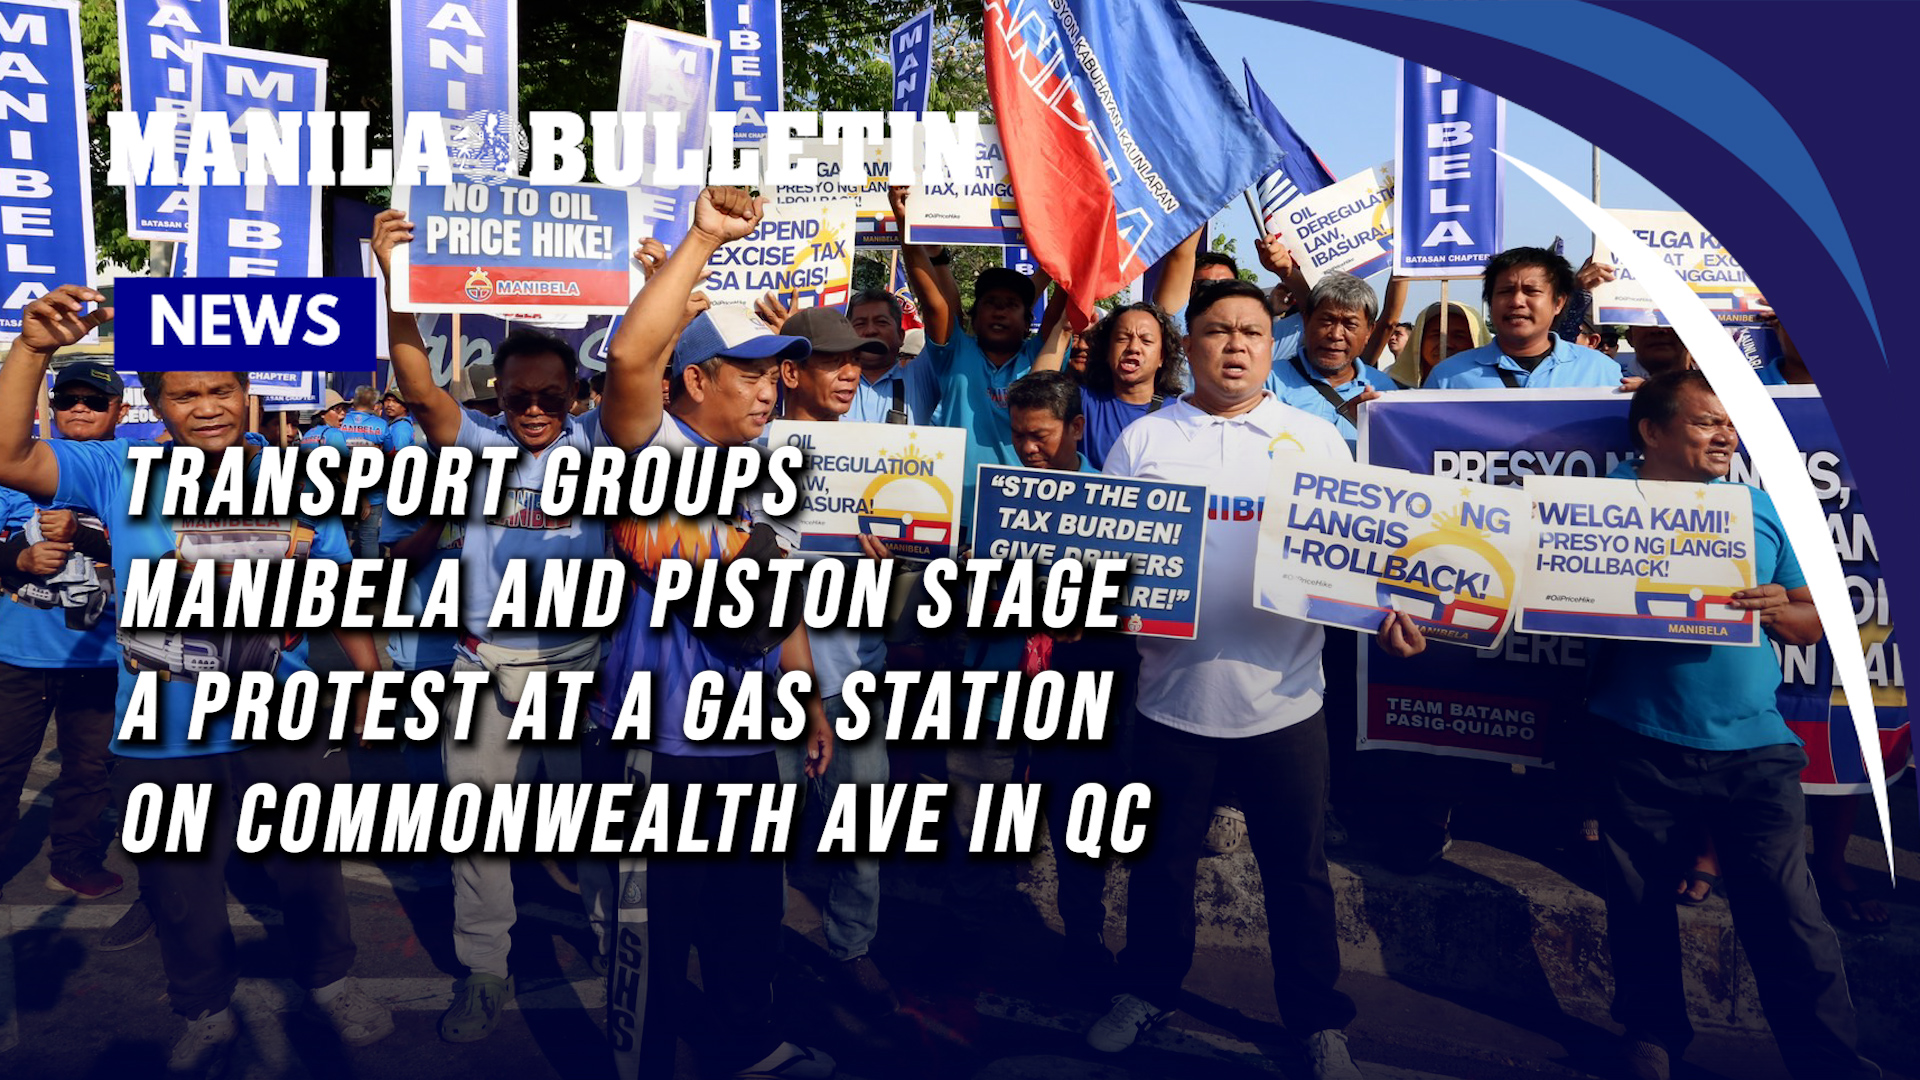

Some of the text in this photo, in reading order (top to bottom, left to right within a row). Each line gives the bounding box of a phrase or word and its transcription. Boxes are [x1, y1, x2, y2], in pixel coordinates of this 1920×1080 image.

[0, 13, 56, 310] MANIBELA
[1119, 130, 1175, 211] KAUNLARAN
[443, 182, 598, 222] NO TO OIL
[1290, 206, 1317, 225] OIL
[141, 219, 182, 229] BATASAN
[427, 215, 613, 260] PRICE HIKE!
[707, 240, 846, 266] EXCISE TAX
[1304, 227, 1345, 254] LAW,
[1311, 223, 1388, 269] IBASURA!
[1405, 253, 1491, 264] BATASAN CHAPTER
[496, 279, 580, 296] MANIBELA
[705, 266, 829, 291] SA LANGIS!
[248, 371, 297, 382] CHAPTER
[787, 433, 816, 450] OIL
[803, 454, 934, 476] EREGULATION
[800, 496, 874, 514] ASURA!
[1083, 482, 1141, 509] THE
[1146, 488, 1192, 514] OIL
[1292, 471, 1432, 518] PRESYO
[1460, 501, 1511, 535] NG
[998, 506, 1183, 546] TAX BURDEN!
[1286, 502, 1409, 549] LANGIS
[1538, 502, 1730, 534] WELGA KAMI!
[989, 538, 1057, 566] GIVE
[1538, 532, 1747, 560] PRESYO NG LANGIS
[1282, 535, 1490, 600] I-ROLLBACK!
[1536, 554, 1669, 578] I-ROLLBACK!
[1545, 594, 1596, 604] #OilPriceHike
[1667, 623, 1728, 637] MANIBELA
[1387, 697, 1536, 725] TEAM BATANG
[1386, 712, 1535, 741] PASIG-QUIAPO
